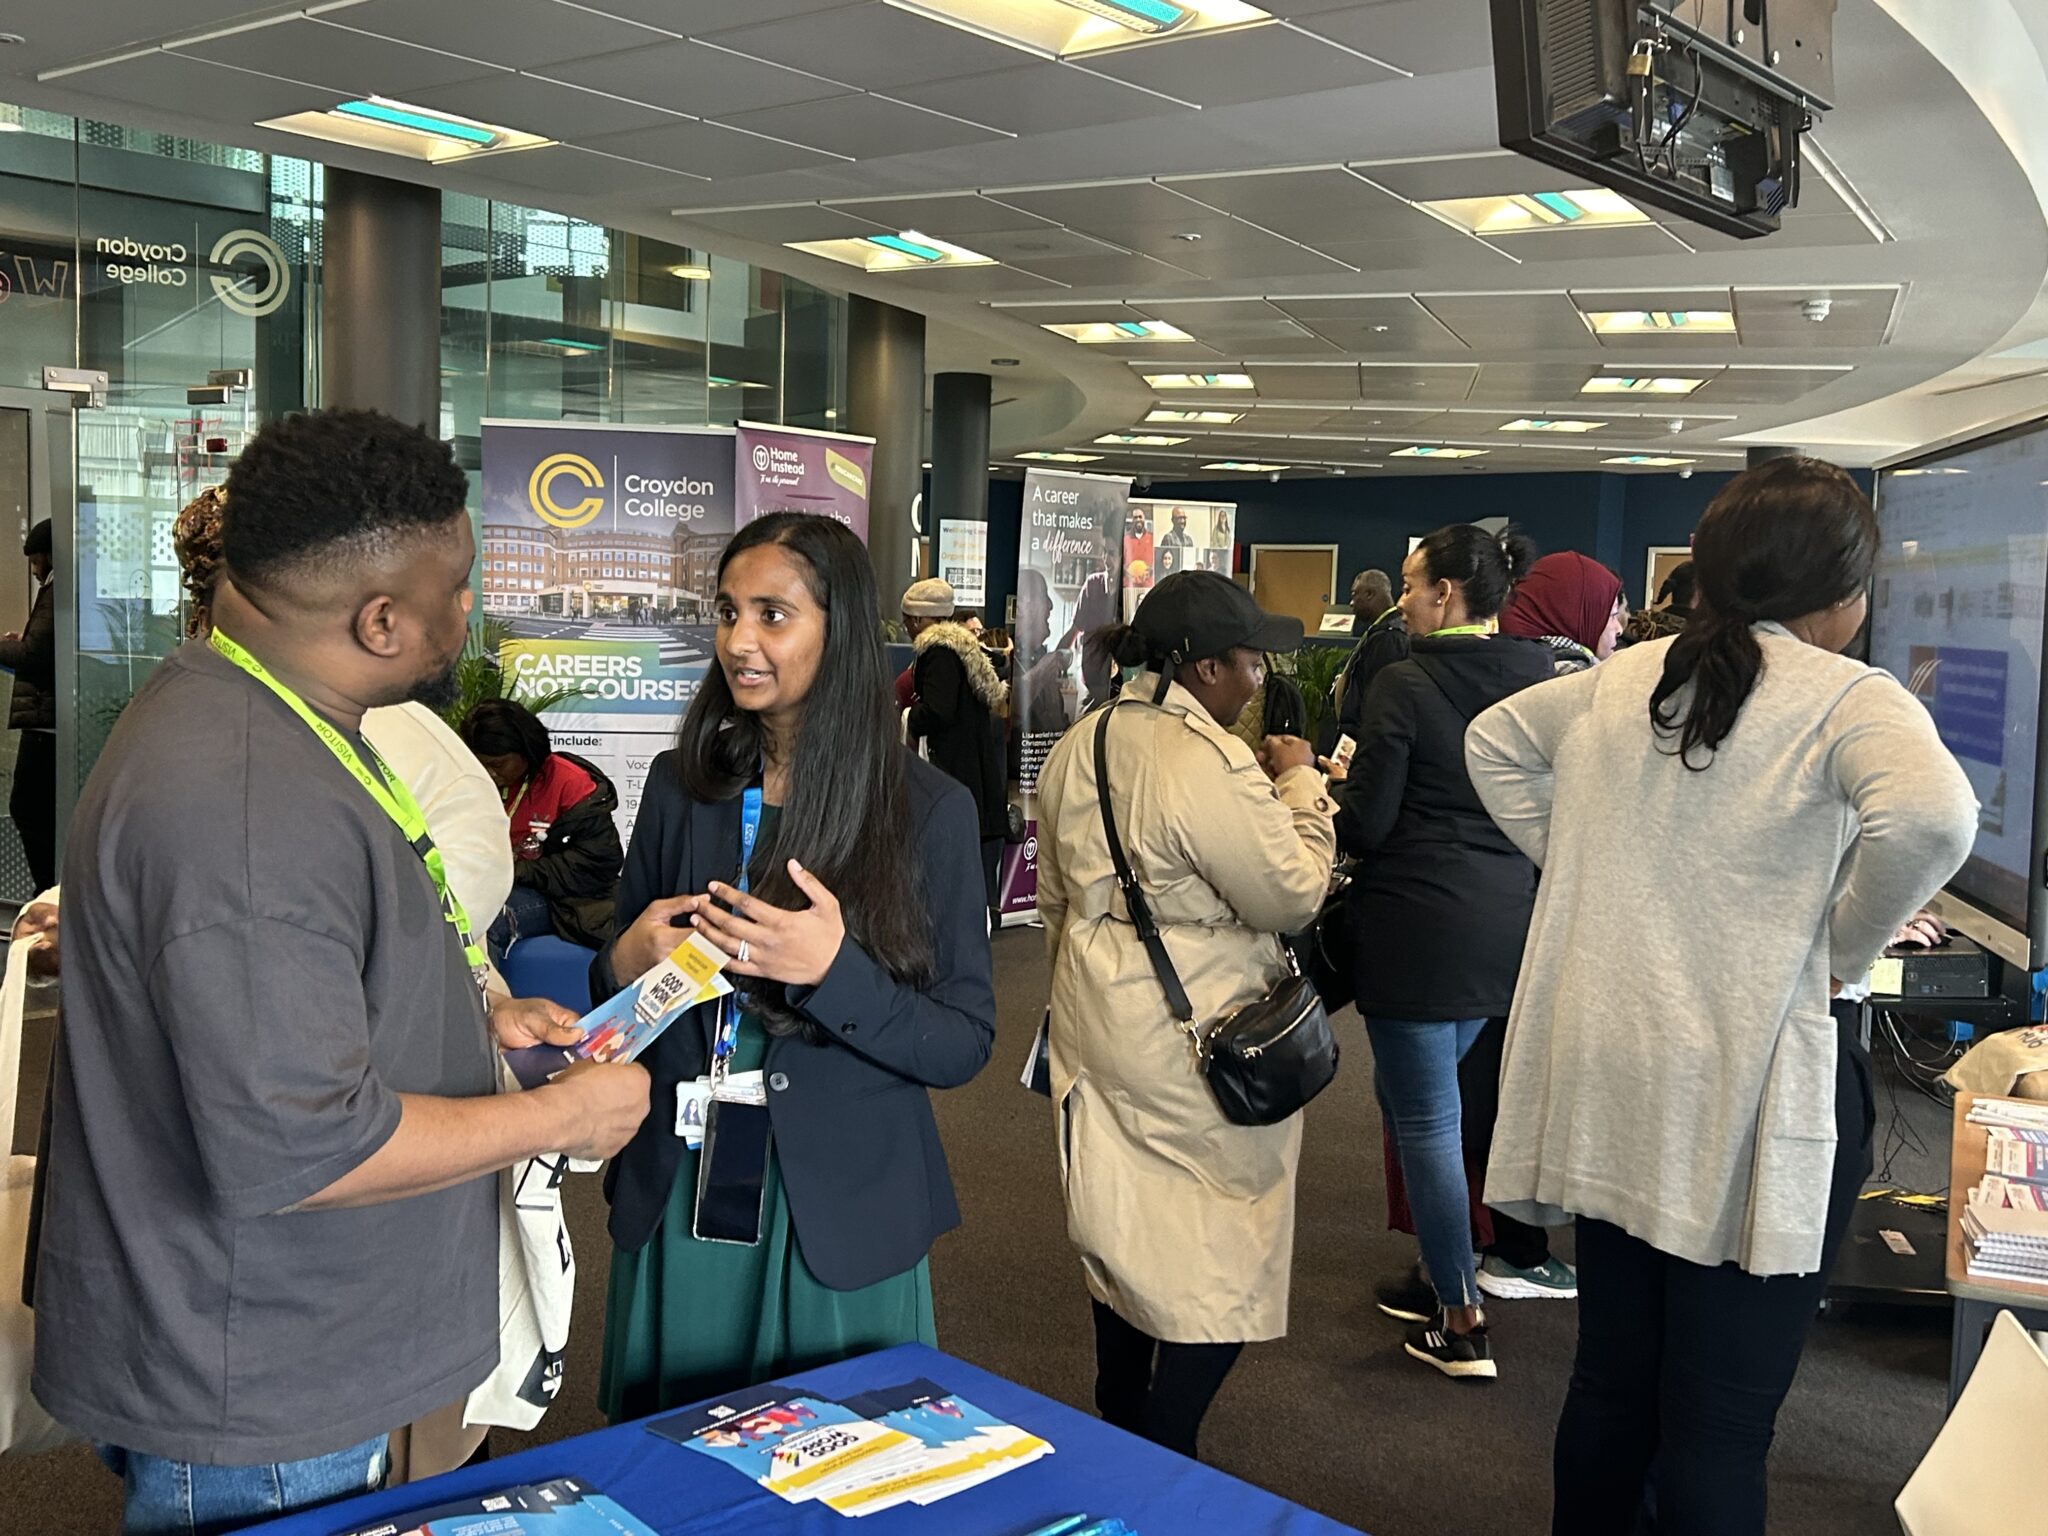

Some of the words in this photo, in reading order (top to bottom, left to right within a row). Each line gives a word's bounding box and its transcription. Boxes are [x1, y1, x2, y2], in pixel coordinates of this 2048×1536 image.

[770, 447, 798, 462] Home
[771, 461, 805, 475] Instead
[624, 474, 714, 500] Croydon
[1032, 485, 1042, 502] A
[1044, 489, 1080, 505] career
[624, 498, 705, 521] College
[1032, 508, 1057, 528] that
[1059, 512, 1093, 530] makes
[1031, 537, 1040, 550] a
[1042, 529, 1094, 564] difference
[514, 653, 642, 677] CAREERS
[515, 677, 574, 698] NOT
[316, 722, 353, 764] VISITOR
[553, 735, 602, 746] include:
[661, 972, 683, 993] GOOD
[650, 983, 674, 1007] WORK
